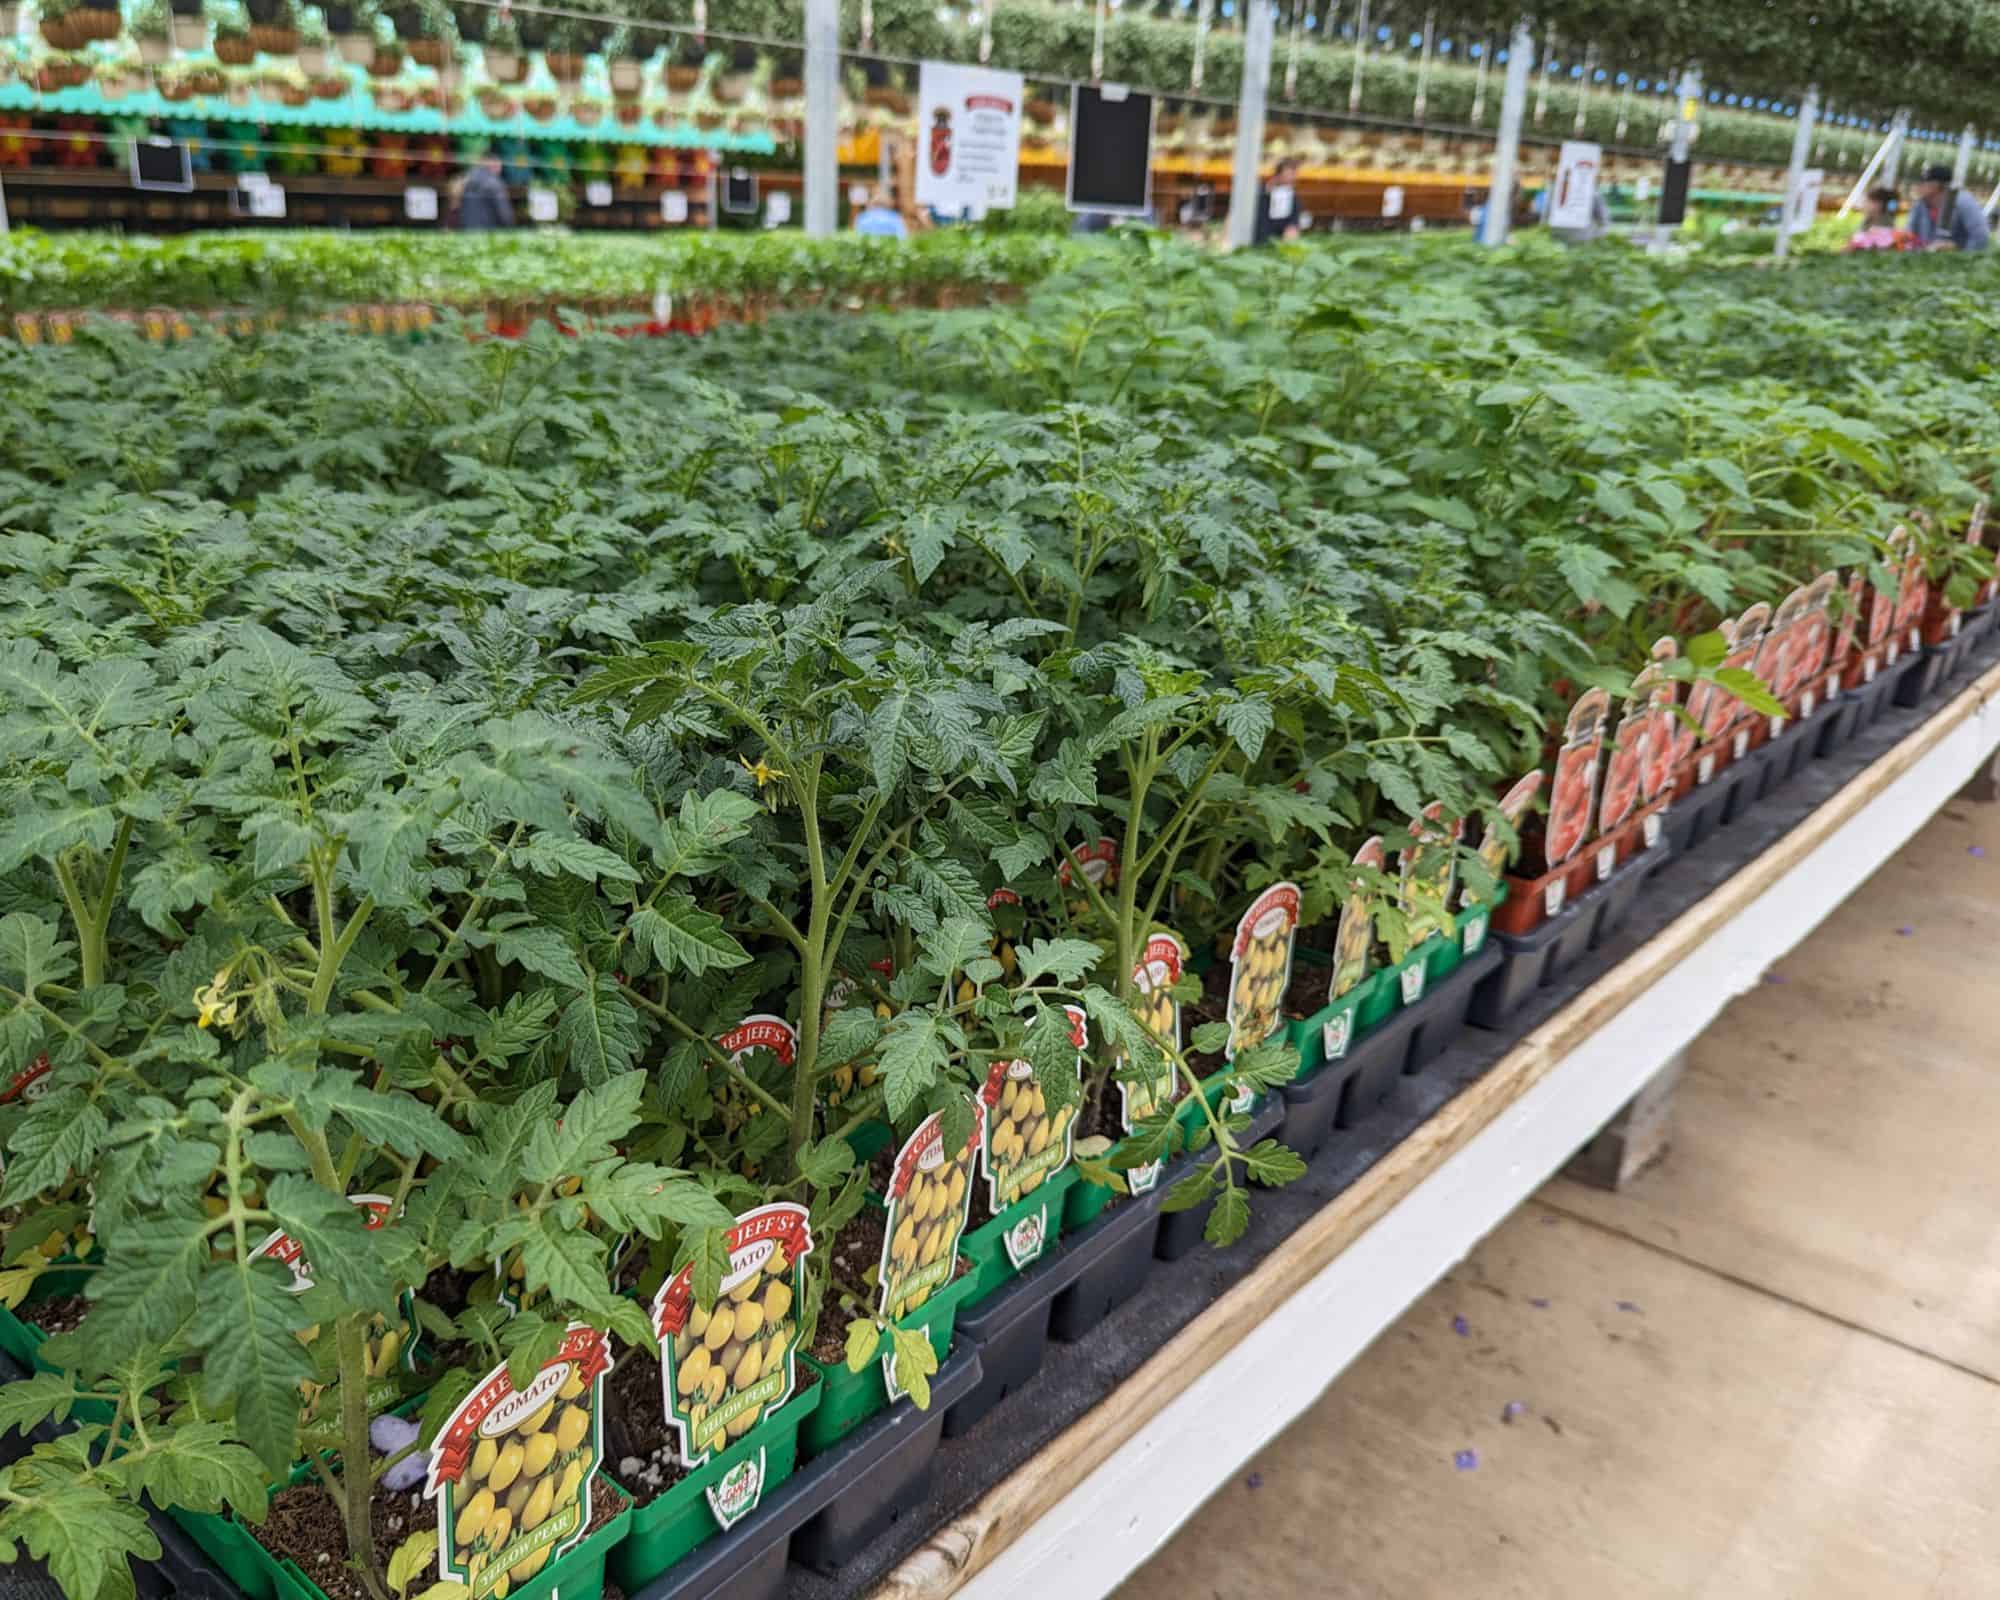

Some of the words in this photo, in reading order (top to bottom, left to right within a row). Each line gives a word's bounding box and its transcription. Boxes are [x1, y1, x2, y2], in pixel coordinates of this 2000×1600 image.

[746, 1025, 782, 1043] JEFF'S
[736, 1215, 790, 1247] JEFF'S
[731, 1246, 768, 1274] MATO
[368, 1385, 394, 1406] EAR
[463, 1376, 513, 1426] CHE
[491, 1371, 561, 1422] TOMATO
[701, 1403, 742, 1440] YELLOW
[743, 1381, 776, 1409] PEAR
[480, 1541, 532, 1587] YELLOW
[532, 1516, 568, 1547] PEAR
